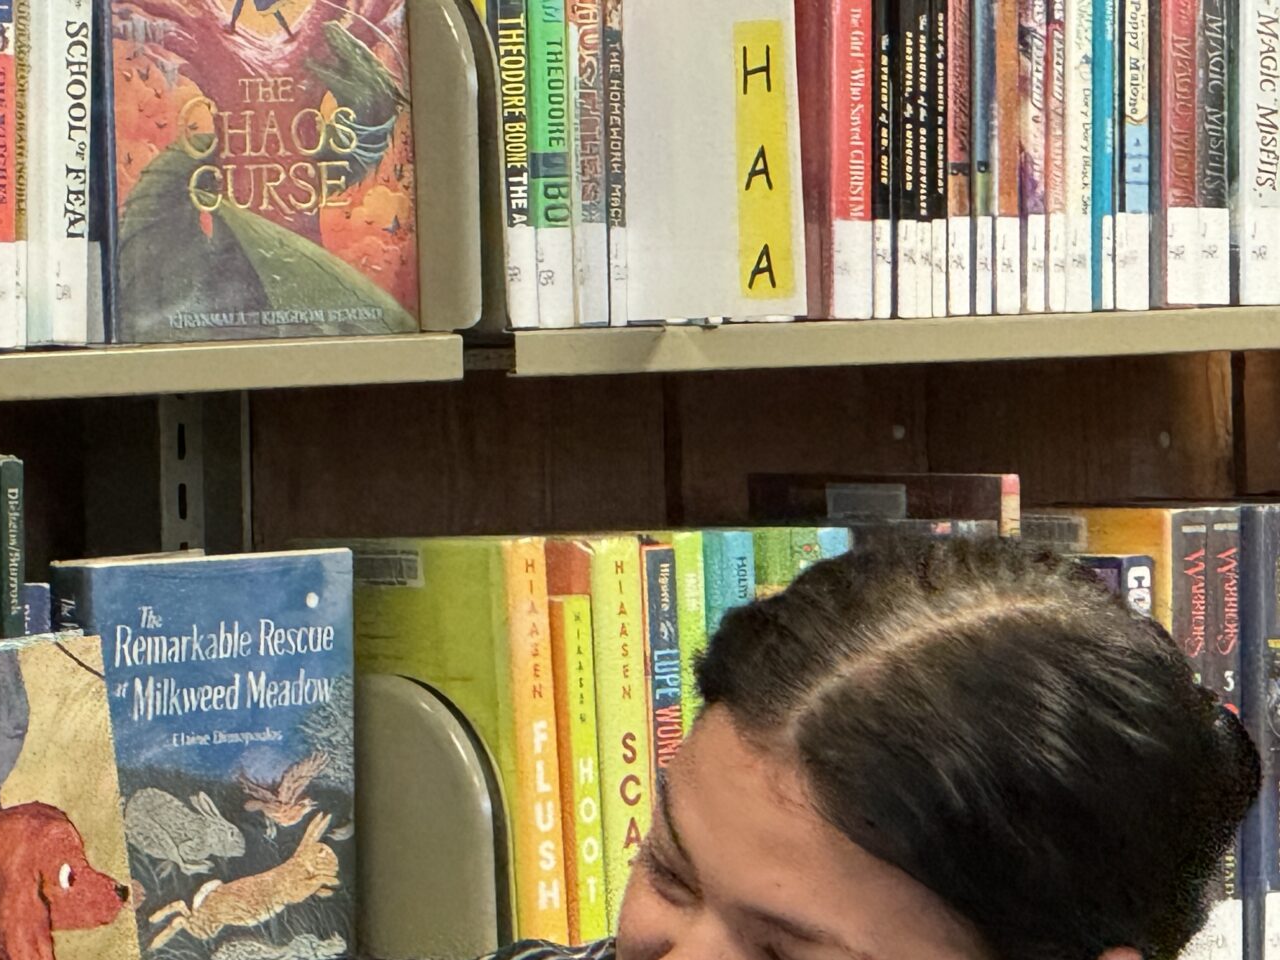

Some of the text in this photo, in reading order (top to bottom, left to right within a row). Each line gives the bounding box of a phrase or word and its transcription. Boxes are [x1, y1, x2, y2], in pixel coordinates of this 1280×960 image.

[1127, 2, 1141, 50] Poppy
[1205, 13, 1227, 94] MAGIC
[1256, 10, 1280, 93] MAGIC
[65, 21, 89, 140] SCHOOL
[238, 77, 297, 103] THE
[497, 13, 528, 209] THEODORE BOONE THE
[850, 68, 866, 101] Who
[177, 95, 357, 158] CHAOS
[543, 38, 570, 228] THEODORE BO
[609, 79, 623, 174] HOMEWORK
[188, 160, 353, 218] CURSE
[850, 149, 866, 220] CHRISTM
[114, 618, 335, 668] Remarkable Rescue
[138, 605, 163, 629] The
[132, 666, 331, 722] Milkweed Meadow
[614, 560, 642, 850] HIAASEN SCA
[653, 649, 680, 700] LUPE
[524, 558, 561, 911] HIAASEN FLUSH
[578, 756, 599, 904] HOOT
